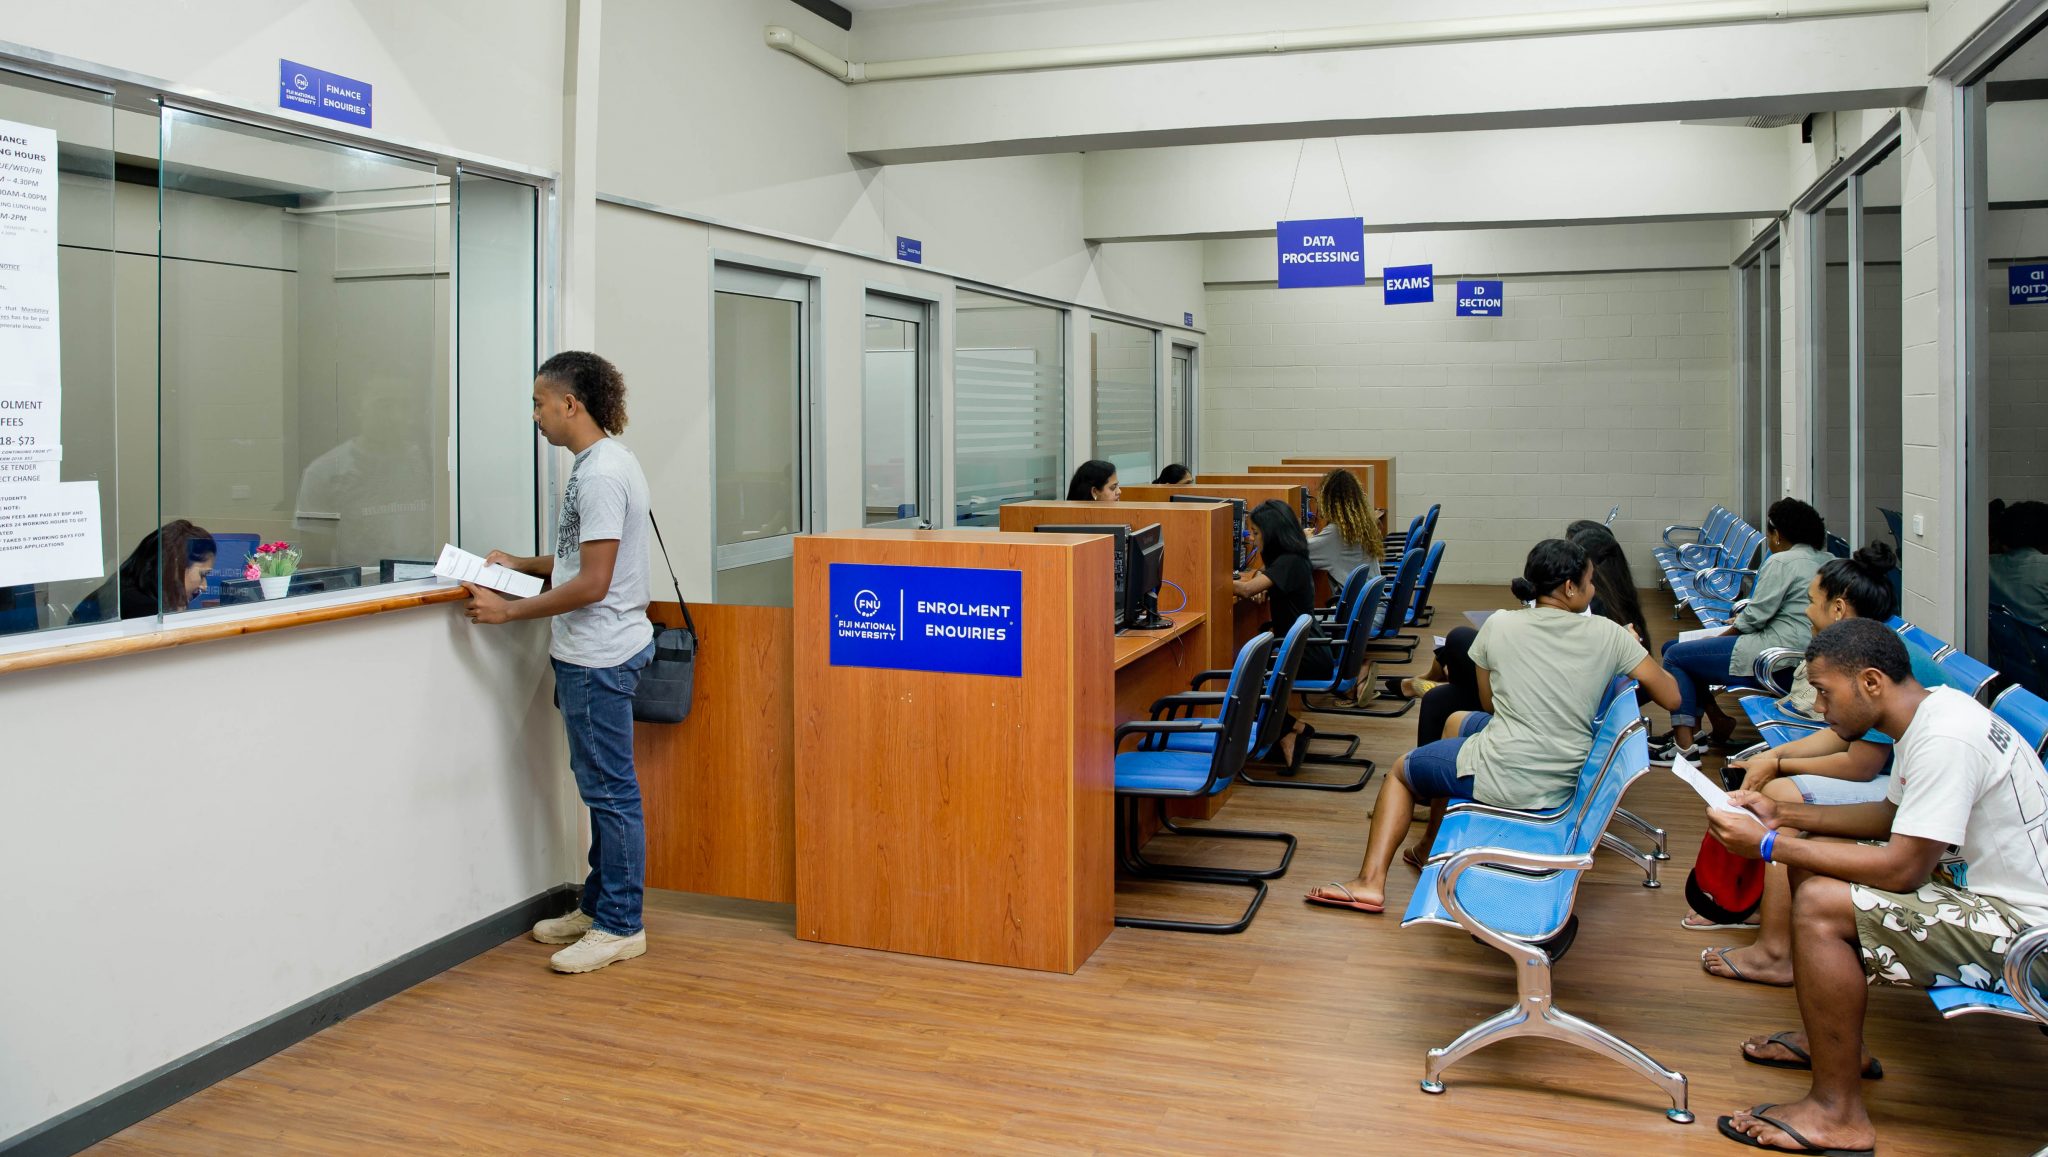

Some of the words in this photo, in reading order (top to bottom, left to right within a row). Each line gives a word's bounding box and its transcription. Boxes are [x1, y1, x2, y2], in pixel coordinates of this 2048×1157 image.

[295, 91, 316, 100] NATIONAL
[326, 84, 361, 100] FINANCE
[286, 94, 317, 105] UNIVERSITY
[323, 98, 366, 115] ENQUIRIES
[14, 150, 46, 162] HOURS
[12, 178, 39, 187] 4.30PM
[0, 212, 27, 221] M-2PM
[1303, 236, 1336, 247] DATA
[1282, 251, 1360, 264] PROCESSING
[1386, 276, 1430, 291] EXAMS
[1474, 286, 1485, 295] ID
[1459, 298, 1501, 307] SECTION
[0, 400, 43, 410] OLMENT
[0, 417, 24, 427] FEES
[18, 435, 35, 446] $73
[11, 463, 37, 471] TENDER
[13, 474, 41, 482] CHANGE
[859, 599, 881, 610] FNU
[917, 601, 1011, 618] ENROLMENT
[838, 620, 853, 629] FIJI
[854, 621, 897, 631] NATIONAL
[838, 629, 896, 640] UNIVERSITY
[925, 624, 1006, 641] ENQUIRIES
